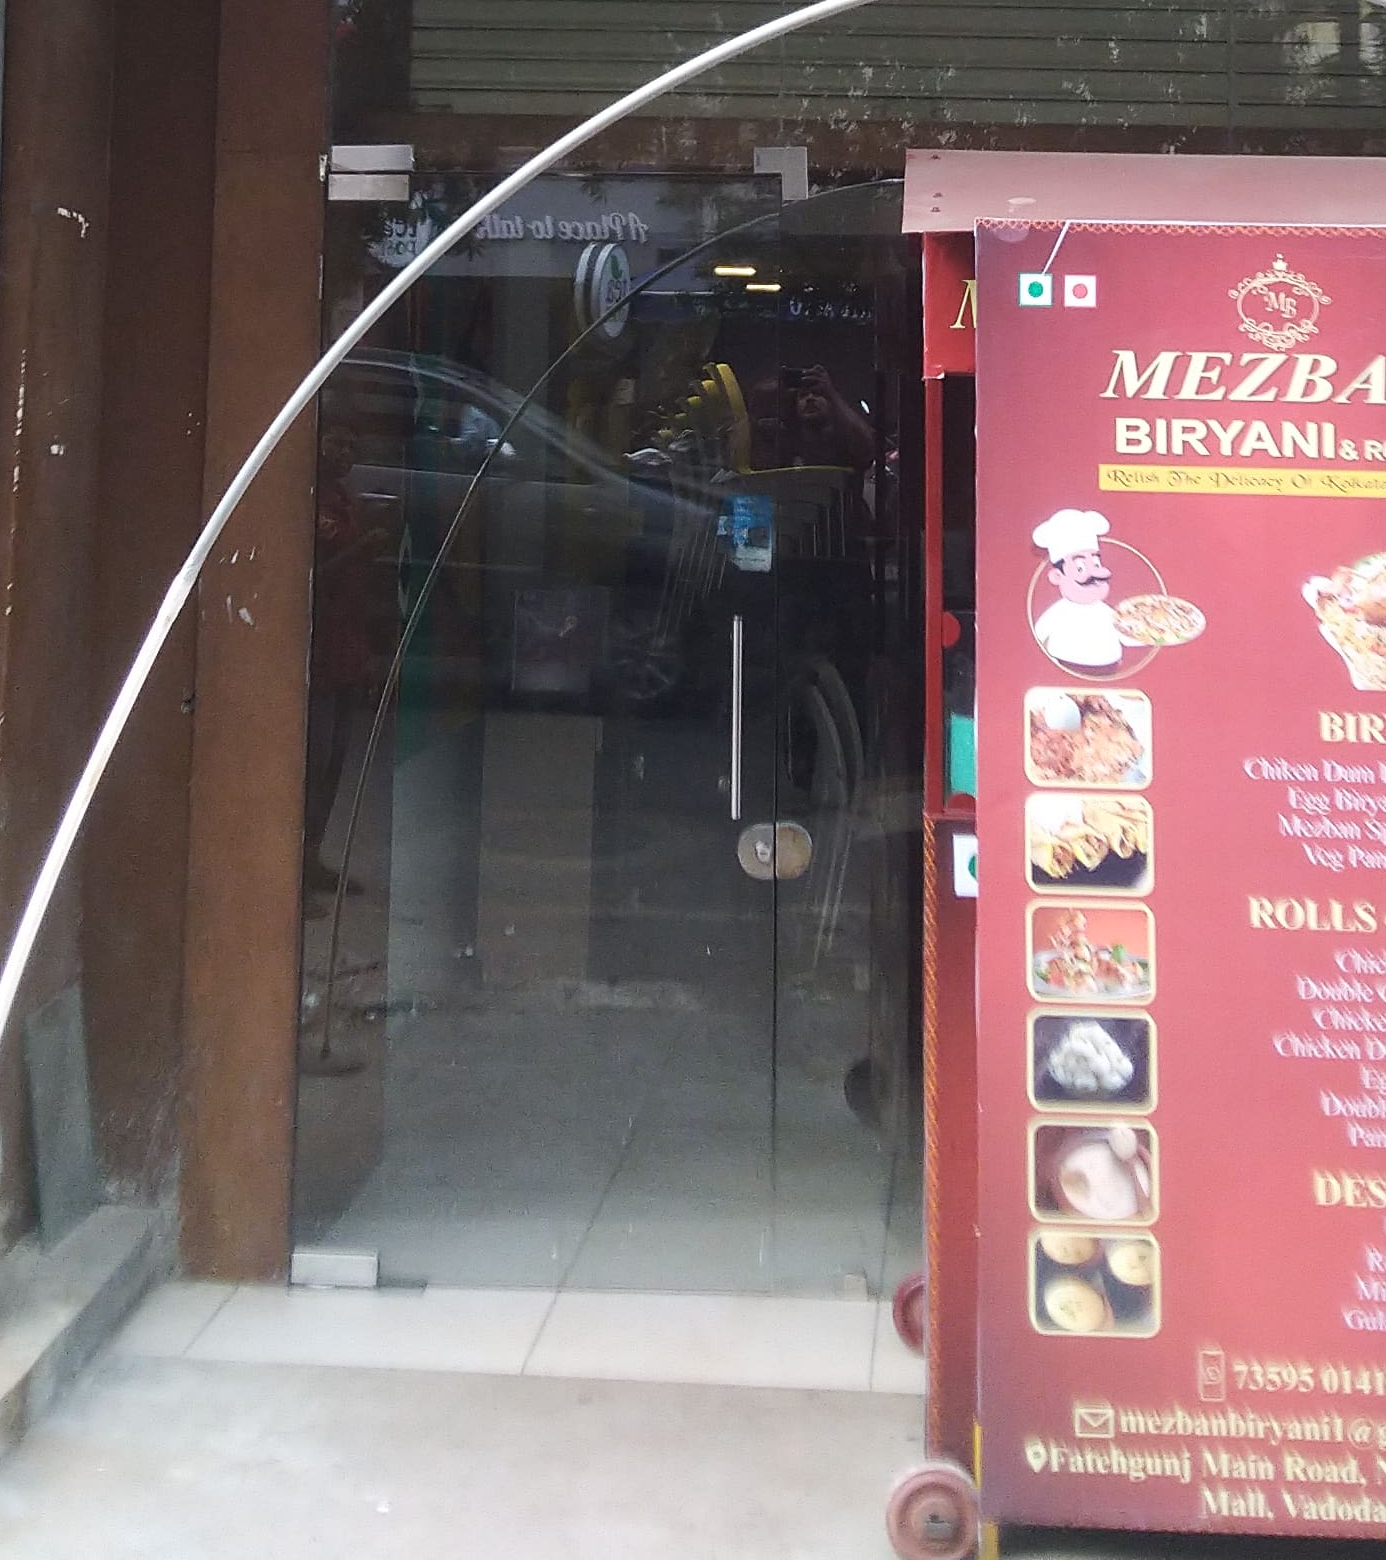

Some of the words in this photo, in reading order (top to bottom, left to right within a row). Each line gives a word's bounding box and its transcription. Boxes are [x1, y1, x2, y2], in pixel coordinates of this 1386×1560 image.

[1115, 416, 1336, 460] BIRYANI
[1338, 438, 1360, 462] &
[1323, 760, 1375, 784] Dum
[1288, 787, 1331, 815] Egg
[1303, 843, 1345, 872] Veg
[1248, 896, 1378, 934] ROLLS
[1296, 974, 1374, 1003] Double
[1274, 1031, 1362, 1060] Chicken
[1233, 1360, 1314, 1393] 73595
[1050, 1441, 1191, 1483] Fatehgunj
[1201, 1446, 1275, 1481] Main
